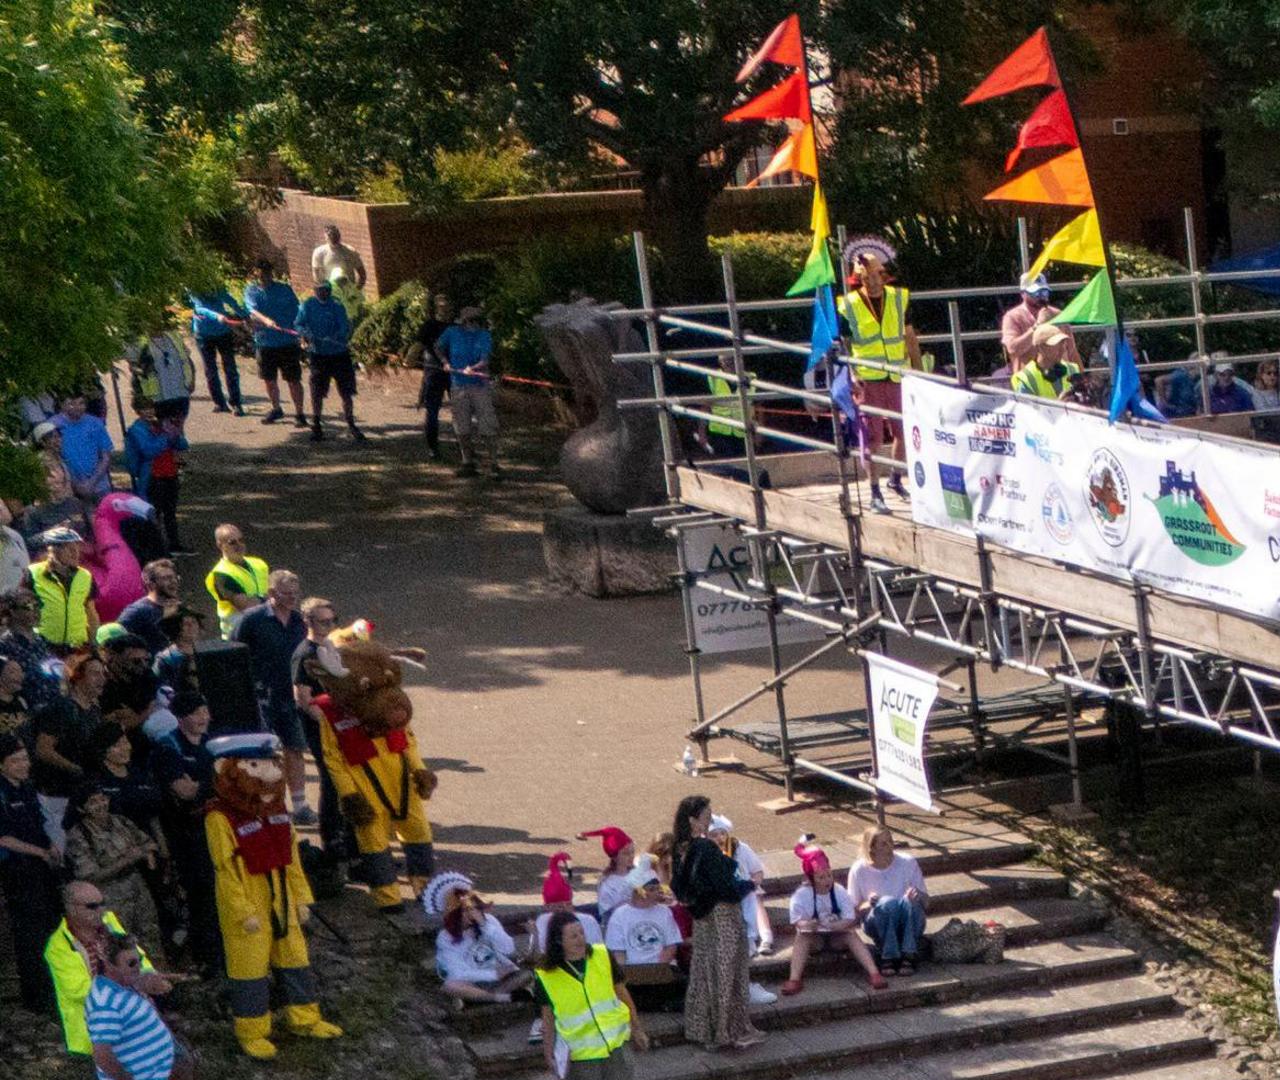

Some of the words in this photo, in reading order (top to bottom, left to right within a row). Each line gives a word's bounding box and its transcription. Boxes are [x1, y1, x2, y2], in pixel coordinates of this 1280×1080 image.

[974, 426, 1011, 440] RAMEN
[1164, 516, 1217, 536] GRASSROOT
[1172, 533, 1233, 556] COMMUNITIES
[880, 680, 922, 719] ACUTE
